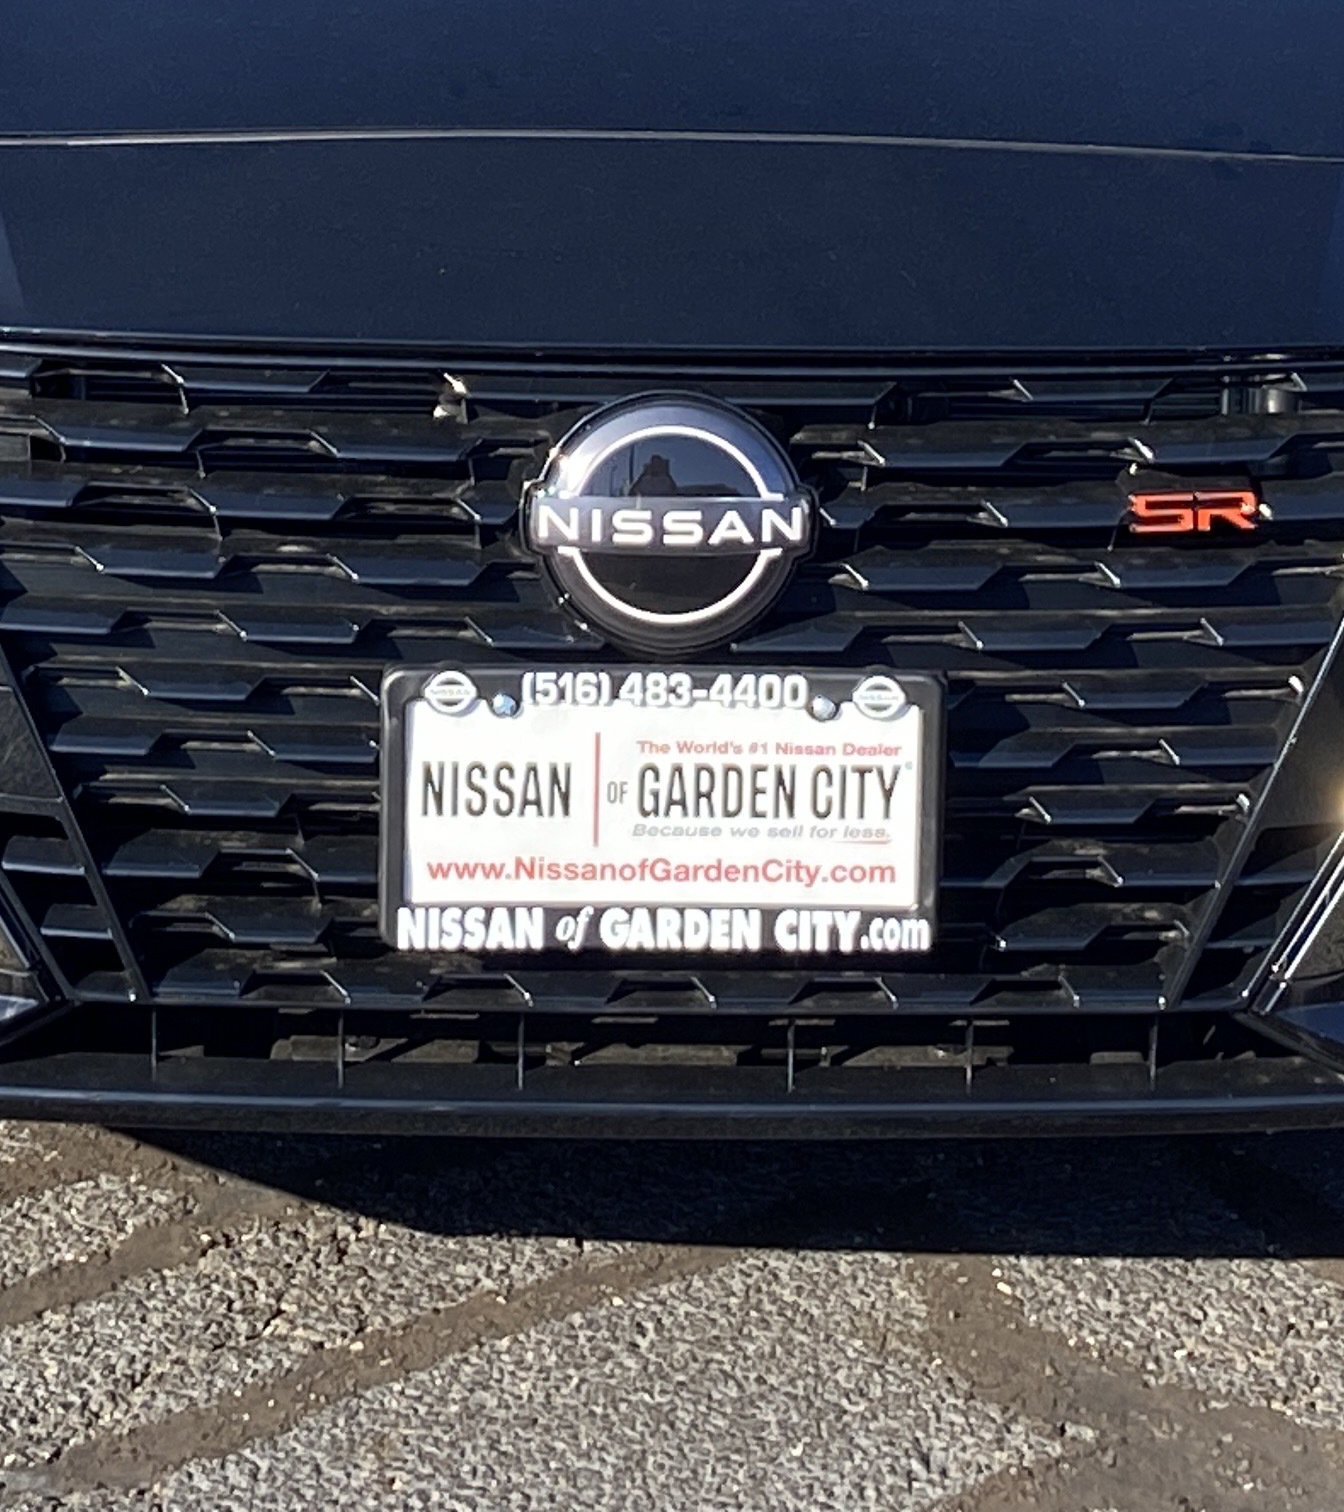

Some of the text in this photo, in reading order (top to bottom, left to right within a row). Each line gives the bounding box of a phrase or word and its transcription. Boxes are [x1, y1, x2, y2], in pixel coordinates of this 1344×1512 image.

[537, 506, 802, 546] NISSAN
[1128, 491, 1258, 534] SR
[522, 672, 807, 709] (516) 483-4400
[636, 740, 902, 757] The World's #1 Nissan Dealer
[421, 760, 901, 820] NISSAN OF GARDEN CITY
[632, 823, 891, 839] Because we sell for less.
[427, 856, 897, 888] www.NissanofGardenCity.com
[397, 906, 544, 950] NISSAN
[555, 905, 594, 950] of
[599, 907, 762, 951] GARDEN
